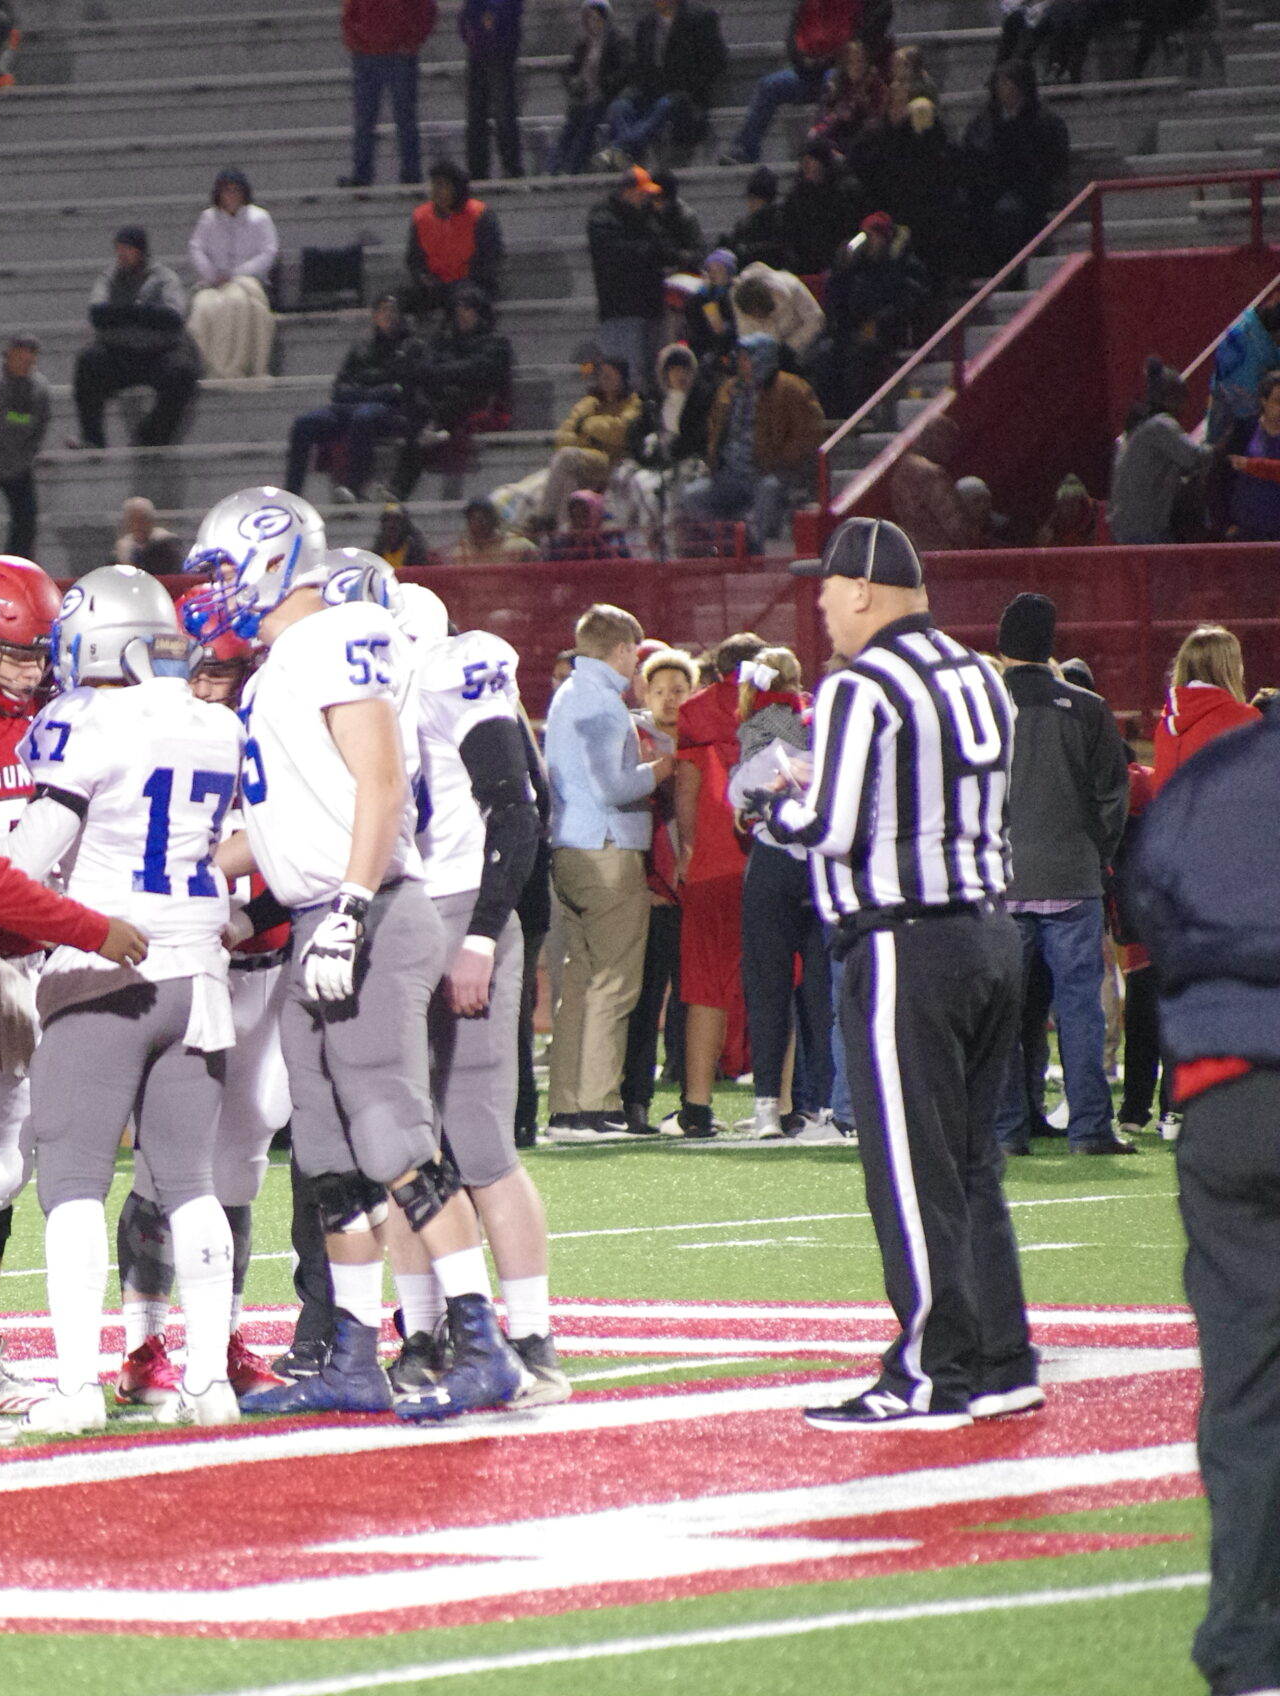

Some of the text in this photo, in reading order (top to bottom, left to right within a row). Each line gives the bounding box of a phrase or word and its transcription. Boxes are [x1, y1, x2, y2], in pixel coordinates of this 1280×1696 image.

[345, 637, 390, 686] 55
[28, 718, 72, 762] 17
[935, 664, 1002, 765] U
[131, 766, 237, 898] 17
